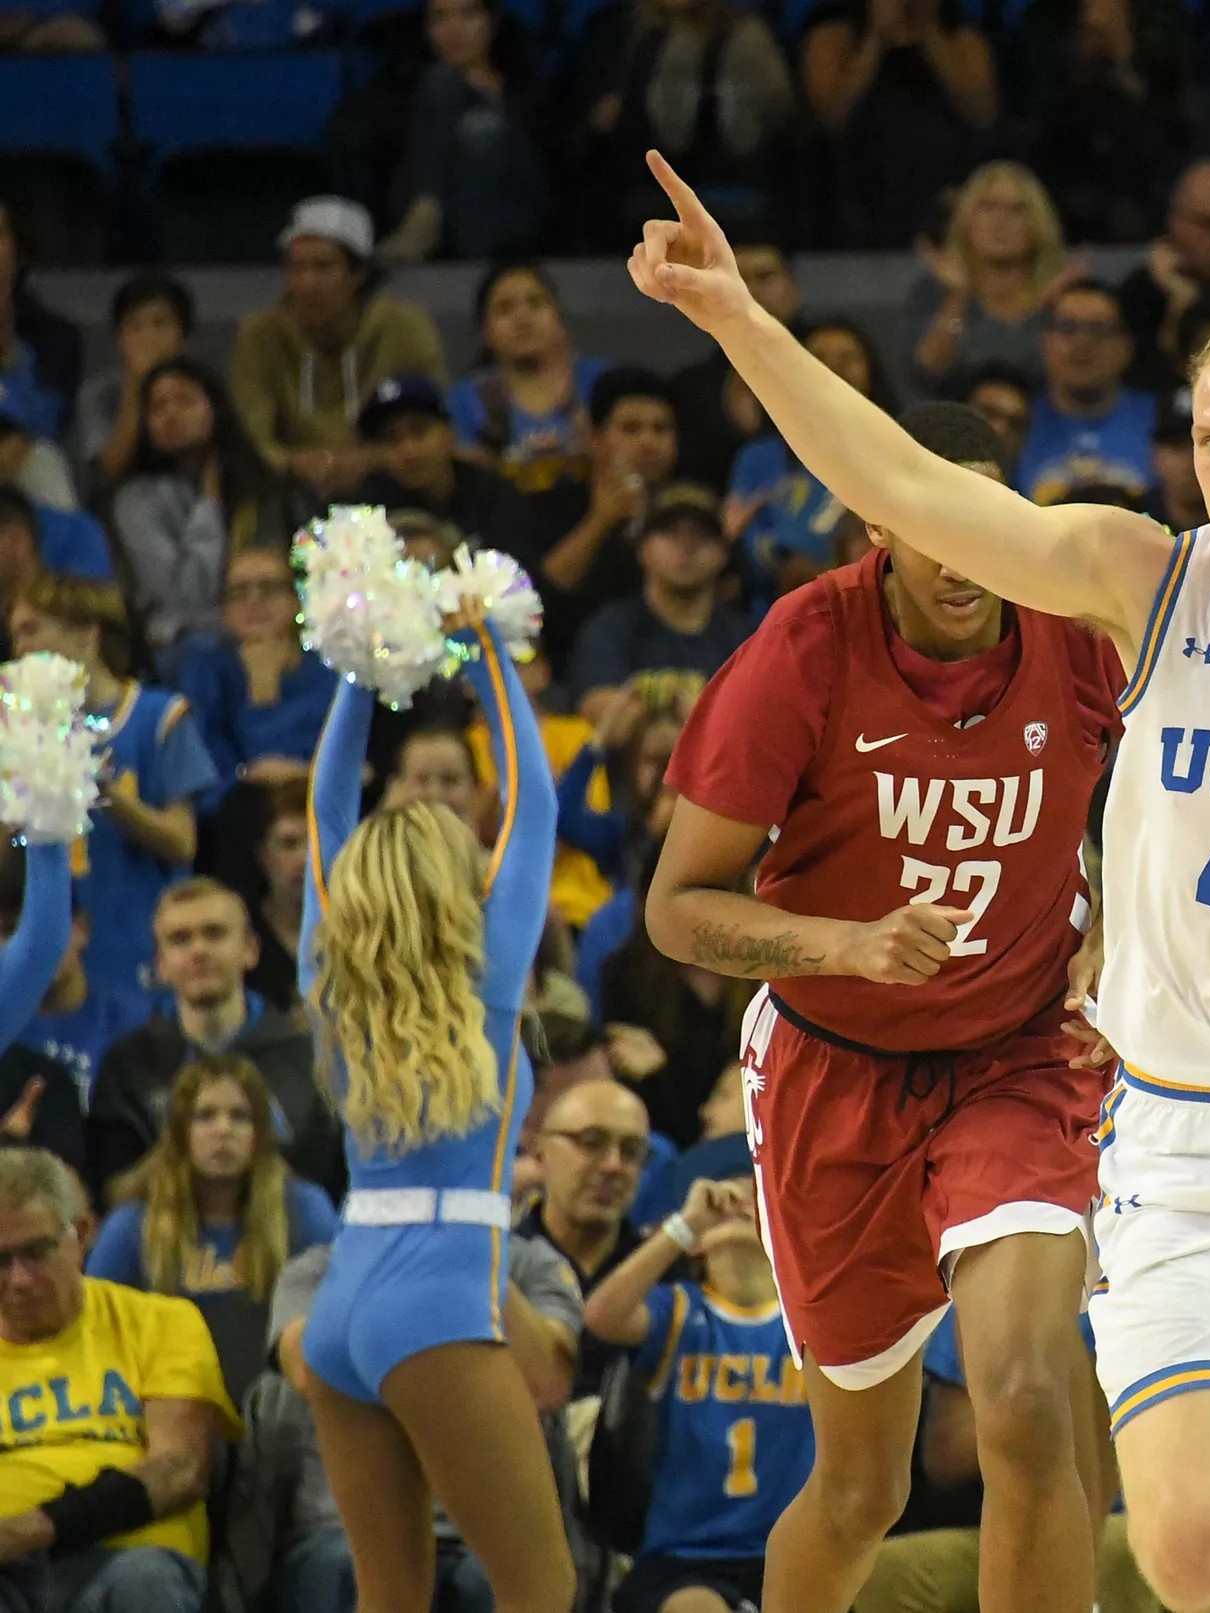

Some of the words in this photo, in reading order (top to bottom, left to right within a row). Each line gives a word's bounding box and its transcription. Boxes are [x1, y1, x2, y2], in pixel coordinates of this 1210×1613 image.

[1030, 736, 1041, 750] 12
[872, 768, 1044, 852] WSU
[0, 1368, 144, 1433] CLA
[675, 1353, 810, 1408] UCLA
[722, 1416, 759, 1498] 1
